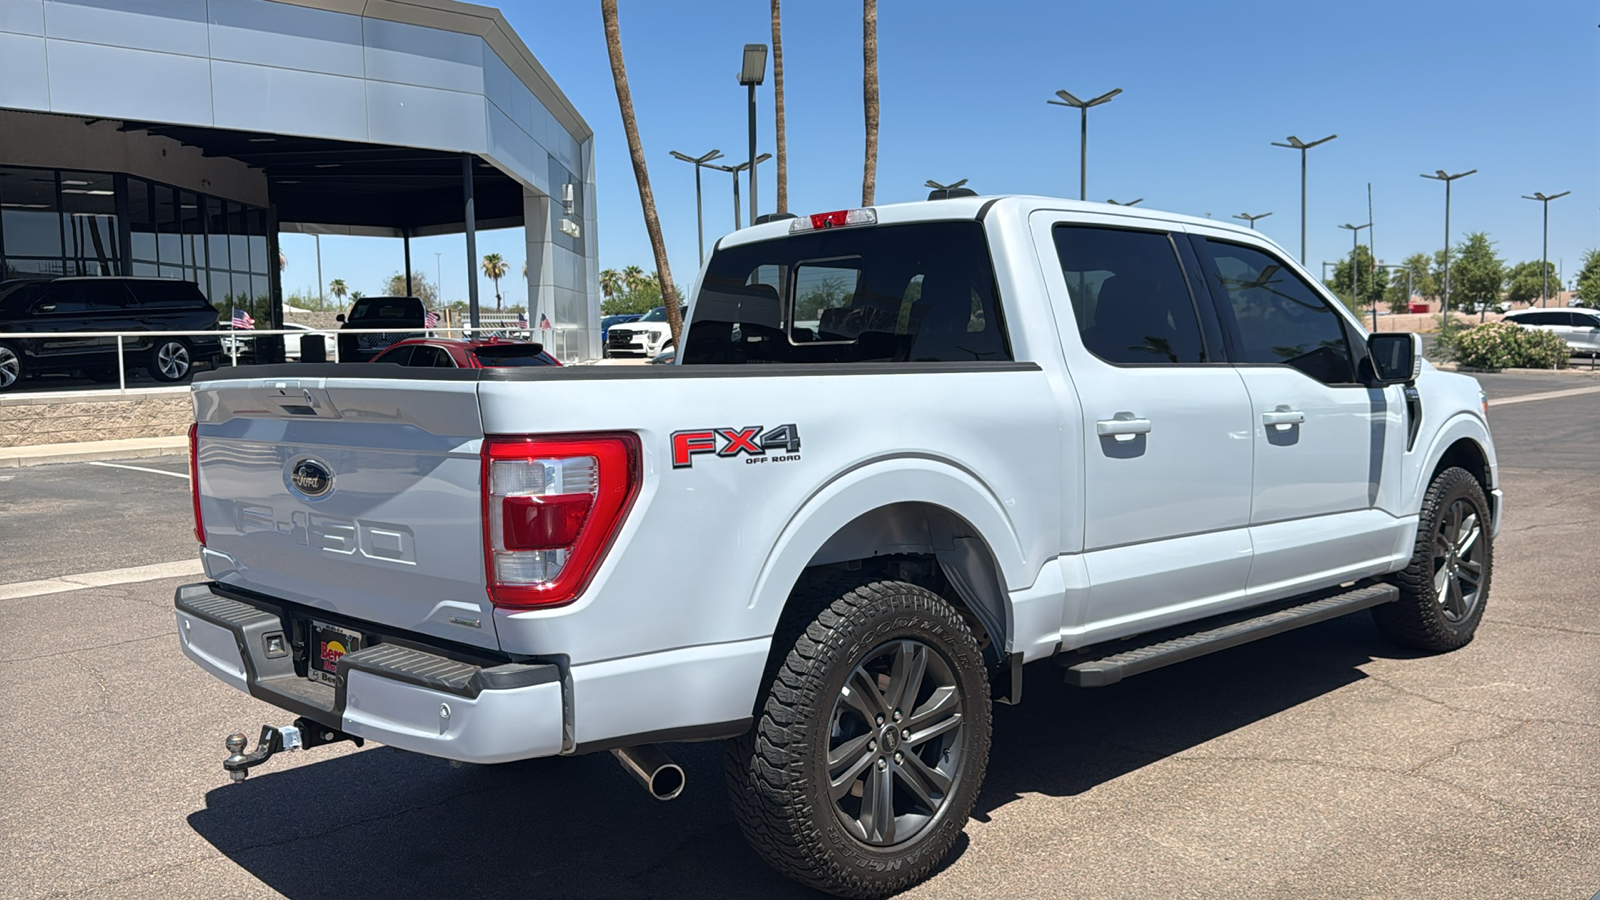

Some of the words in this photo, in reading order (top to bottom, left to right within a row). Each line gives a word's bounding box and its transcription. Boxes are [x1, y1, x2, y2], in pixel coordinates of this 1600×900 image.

[670, 423, 802, 470] FX4
[745, 456, 768, 465] OFF
[771, 454, 802, 463] ROAD
[235, 500, 418, 566] F-150
